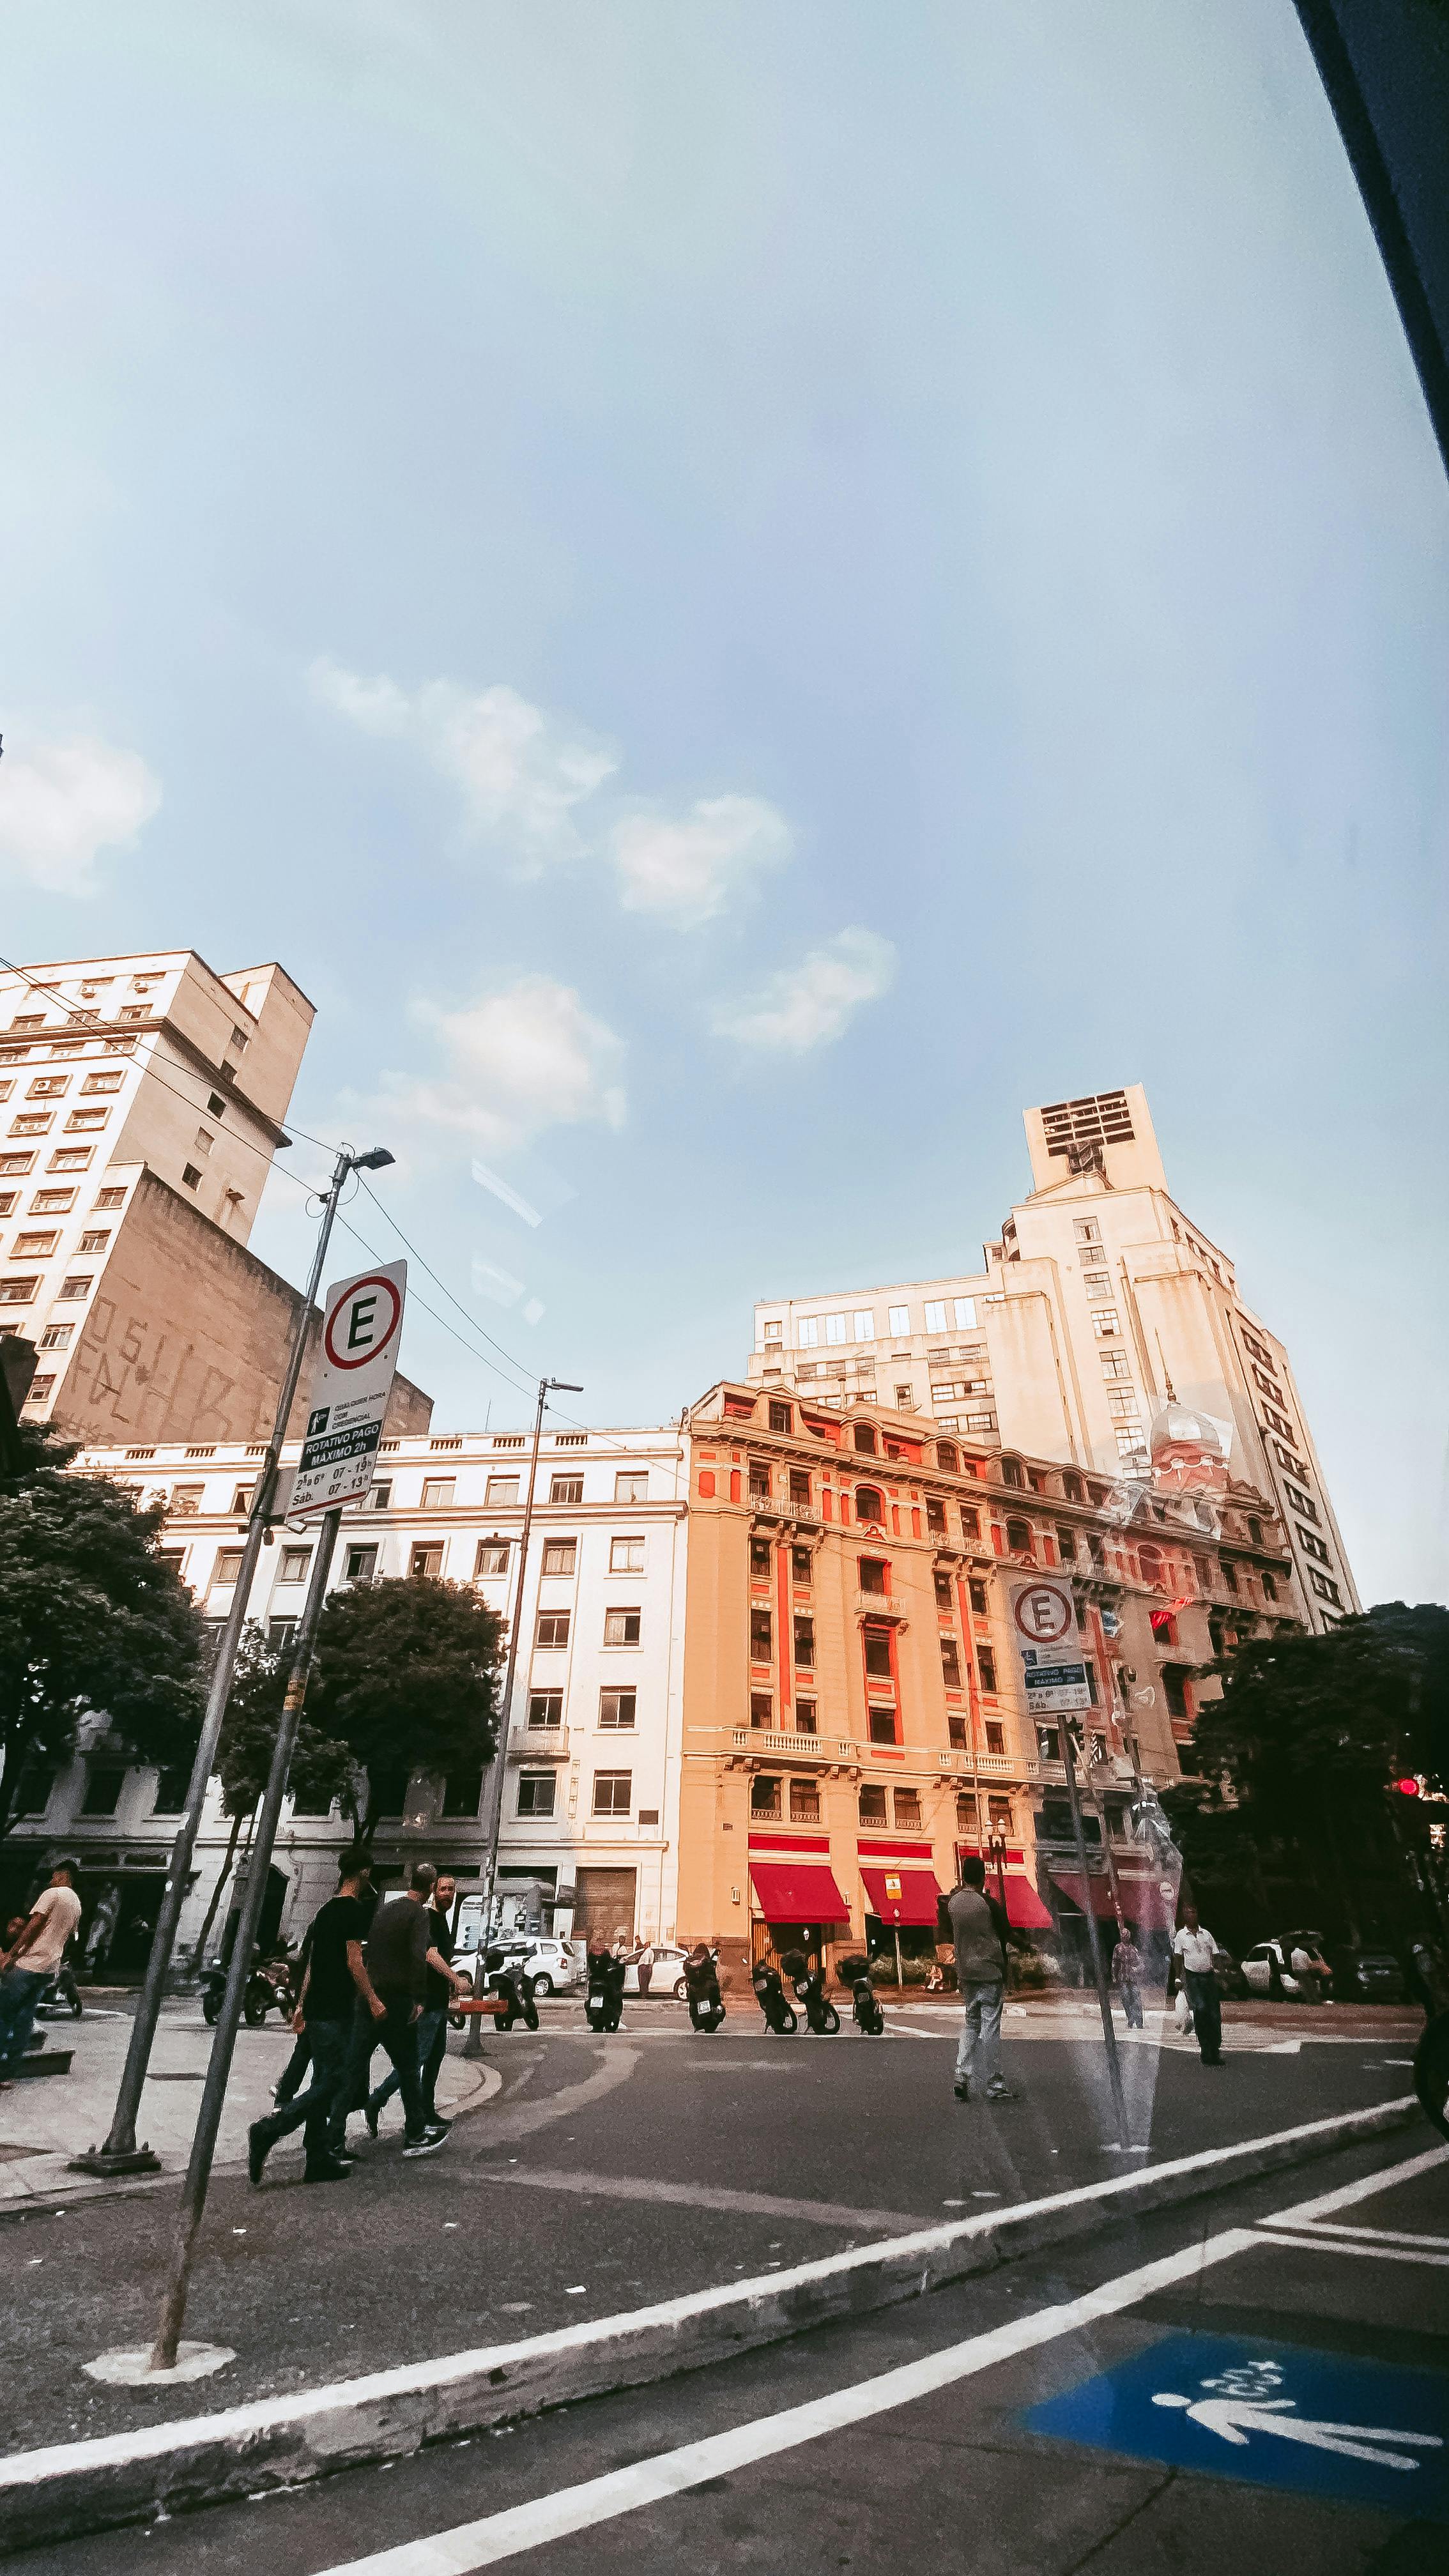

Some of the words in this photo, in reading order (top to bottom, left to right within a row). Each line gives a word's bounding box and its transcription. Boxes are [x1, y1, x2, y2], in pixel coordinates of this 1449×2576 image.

[347, 1294, 378, 1350] E
[306, 1432, 351, 1455] ROTATIVO
[351, 1424, 379, 1441] PAGO
[310, 1445, 352, 1466] MÁXIMO
[353, 1441, 367, 1454] 2h
[307, 1478, 312, 1487] a
[333, 1466, 346, 1480] 07
[292, 1491, 314, 1506] Sáb.
[328, 1482, 342, 1496] 07
[1031, 1595, 1055, 1631] E
